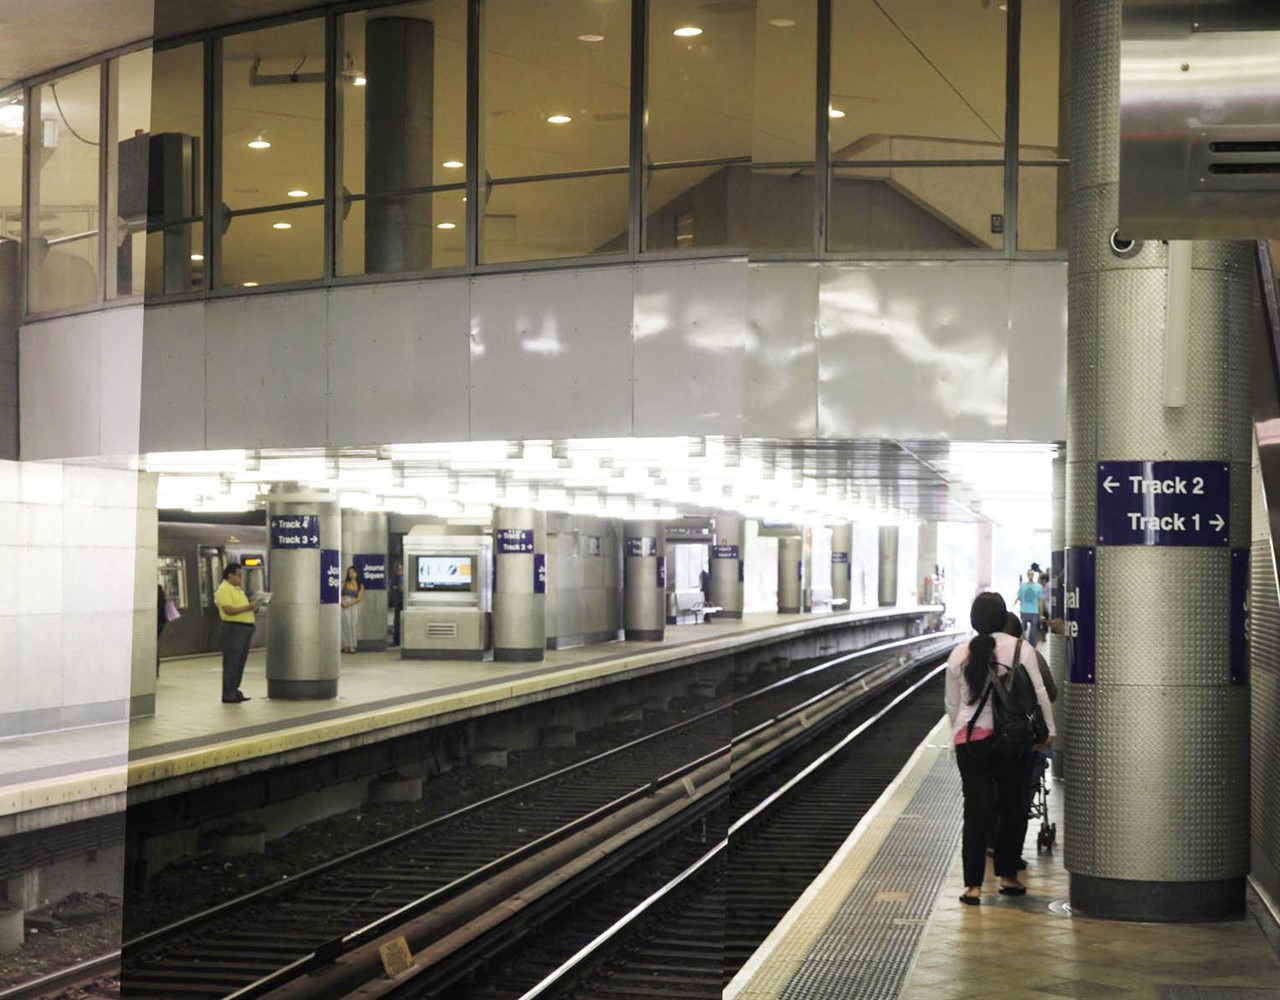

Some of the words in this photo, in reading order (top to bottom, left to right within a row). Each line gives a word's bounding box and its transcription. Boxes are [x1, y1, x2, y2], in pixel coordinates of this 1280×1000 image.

[1129, 476, 1187, 494] Track
[1192, 477, 1204, 494] 2
[278, 520, 301, 529] Track
[302, 520, 308, 528] 4
[1127, 513, 1186, 531] Track
[1192, 513, 1201, 531] 1
[278, 535, 301, 544] Track
[302, 535, 308, 544] 3
